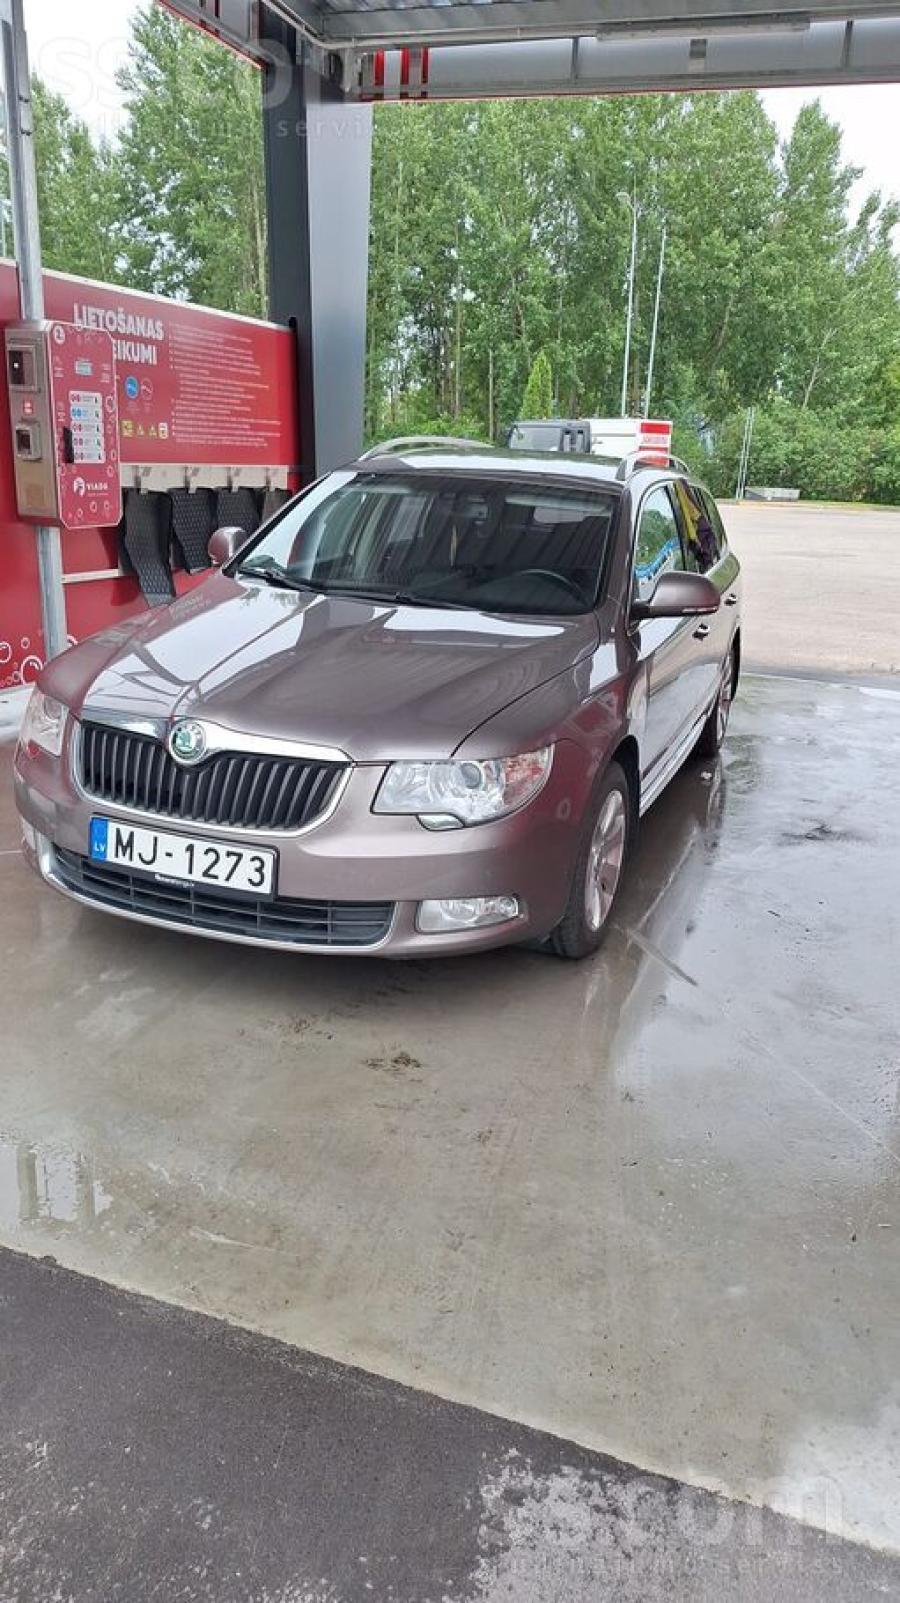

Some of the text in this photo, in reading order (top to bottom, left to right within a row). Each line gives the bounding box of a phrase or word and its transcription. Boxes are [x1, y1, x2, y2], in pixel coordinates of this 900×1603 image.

[73, 302, 164, 341] LIETOŠANAS
[94, 842, 105, 854] LV
[114, 827, 266, 887] MJ-1273
